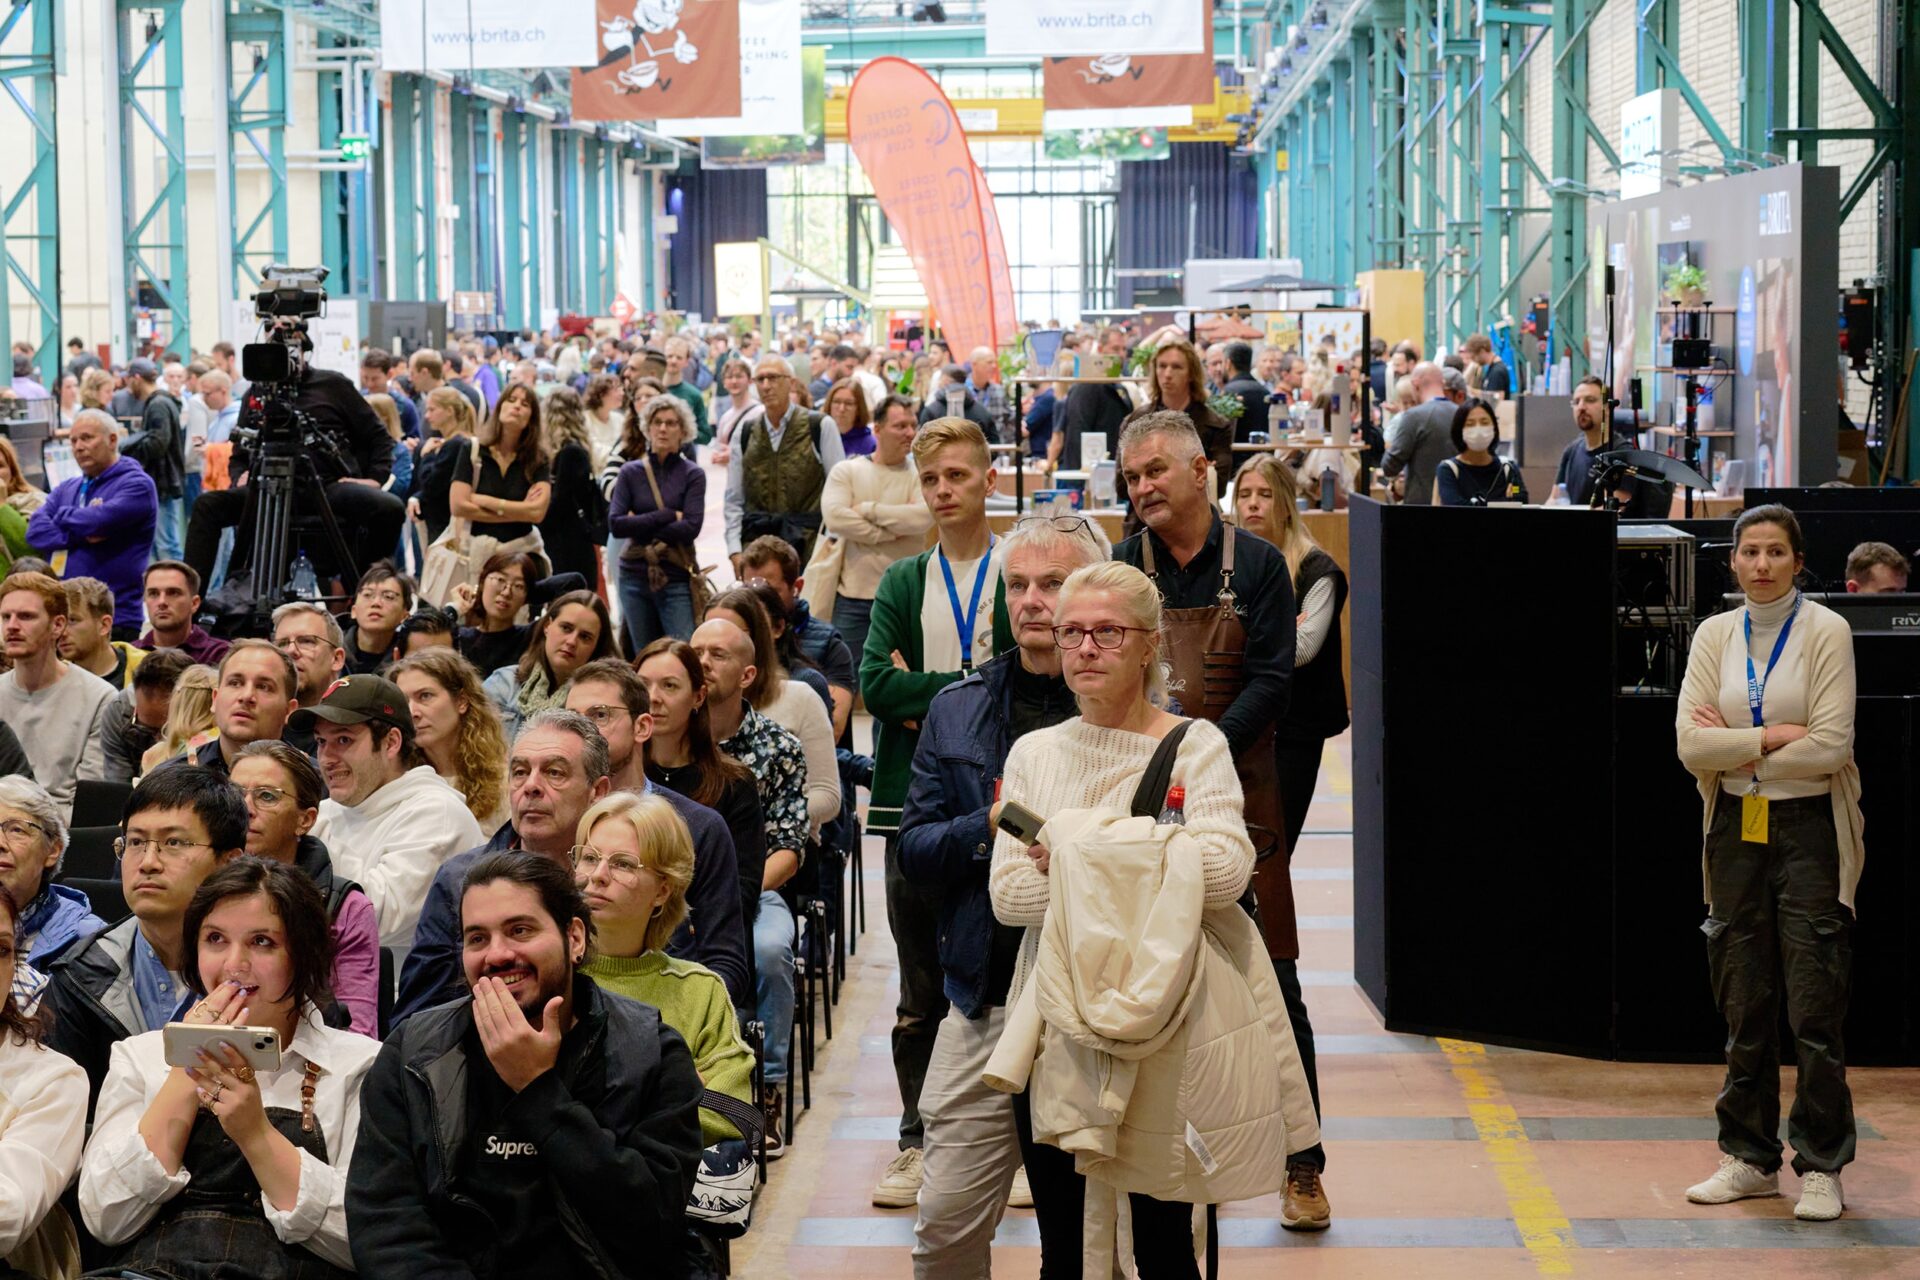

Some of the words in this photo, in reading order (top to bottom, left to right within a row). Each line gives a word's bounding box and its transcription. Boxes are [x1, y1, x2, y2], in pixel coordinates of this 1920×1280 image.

[1037, 11, 1153, 28] www.brita.ch
[431, 26, 546, 43] www.brita.ch
[744, 36, 766, 47] FEE
[744, 50, 789, 61] CHING
[1767, 190, 1791, 235] BRITA
[1748, 678, 1758, 700] BRITA
[485, 1135, 538, 1160] Supre
